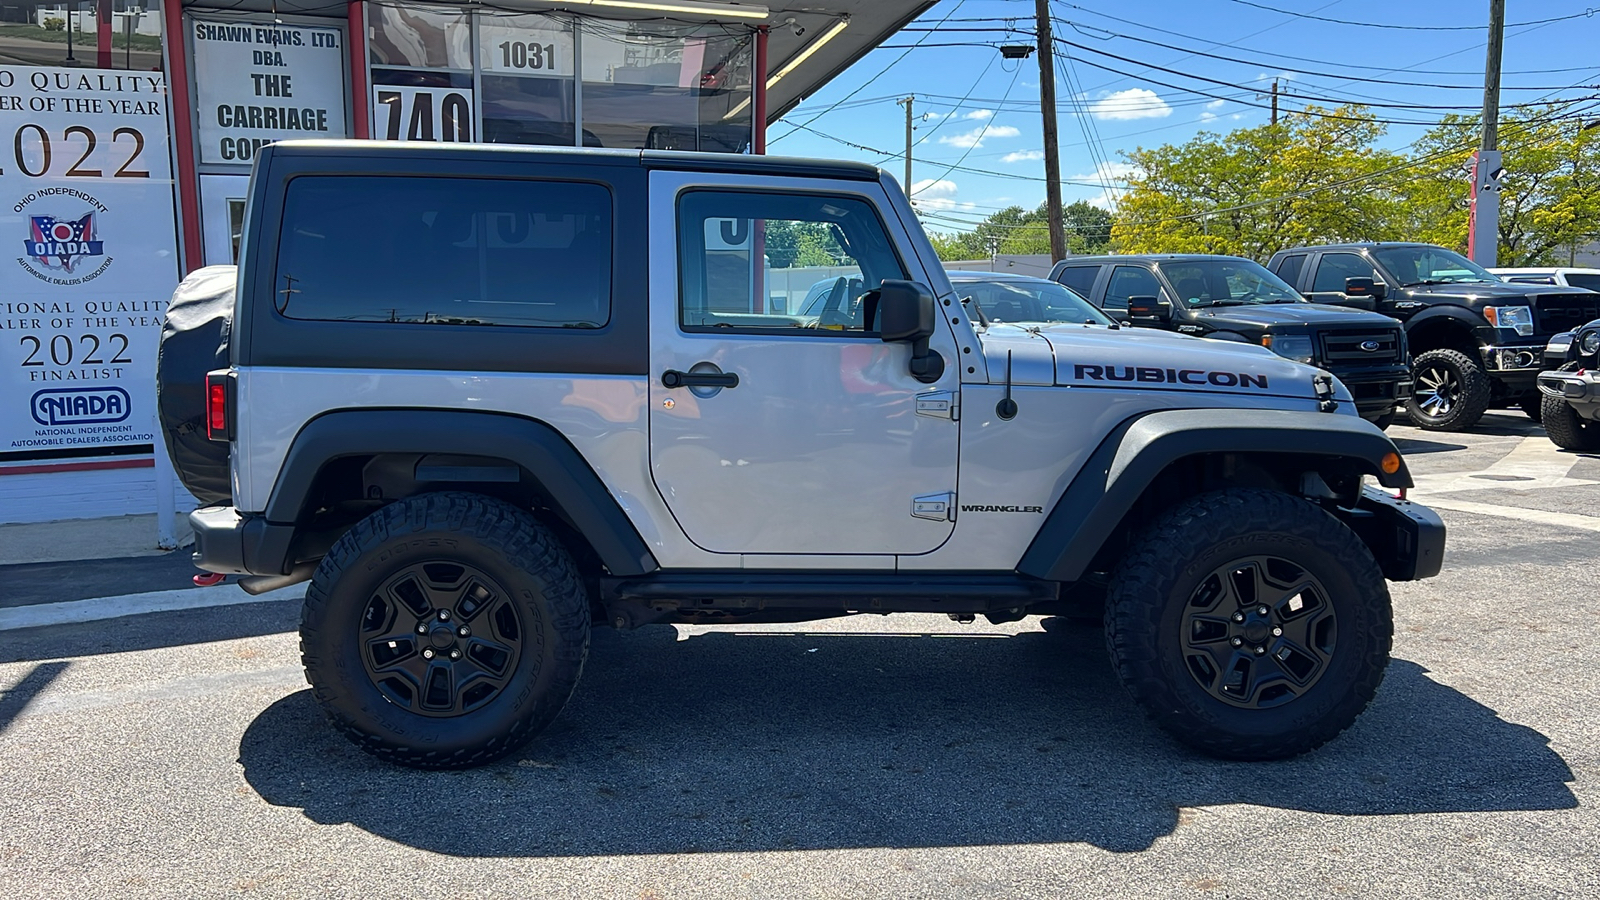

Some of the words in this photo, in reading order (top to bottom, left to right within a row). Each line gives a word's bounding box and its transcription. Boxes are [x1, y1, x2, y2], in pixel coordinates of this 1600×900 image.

[196, 24, 251, 43] SHAWN
[311, 32, 339, 49] LTD.
[253, 50, 287, 67] DBA.
[499, 41, 555, 70] 1031
[30, 72, 161, 93] QUALITY
[251, 73, 292, 98] THE
[29, 96, 56, 112] OF
[61, 98, 103, 114] THE
[108, 100, 161, 116] YEAR
[217, 104, 328, 131] CARRIAGE
[378, 91, 470, 142] 740
[0, 123, 150, 178] 022
[13, 193, 36, 213] OHIO
[36, 187, 108, 214] INDEPENDENT
[35, 242, 91, 255] OIADA
[17, 257, 52, 284] AUTOMOBILE
[53, 278, 81, 286] DEALERS
[82, 256, 114, 283] ASSOCIATION
[0, 302, 75, 315] IONAL
[51, 317, 74, 330] OF
[83, 316, 119, 329] THE
[127, 316, 162, 328] YEA
[20, 333, 132, 367] 2022
[30, 368, 123, 382] FINALIST
[1074, 363, 1269, 389] RUBICON
[38, 394, 122, 421] NIADA
[11, 437, 64, 447] AUTOMOBILE
[66, 436, 101, 445] DEALERS
[35, 427, 76, 437] NATIONAL
[78, 425, 132, 435] INDEPENDENT
[961, 505, 1044, 514] WRANGLER
